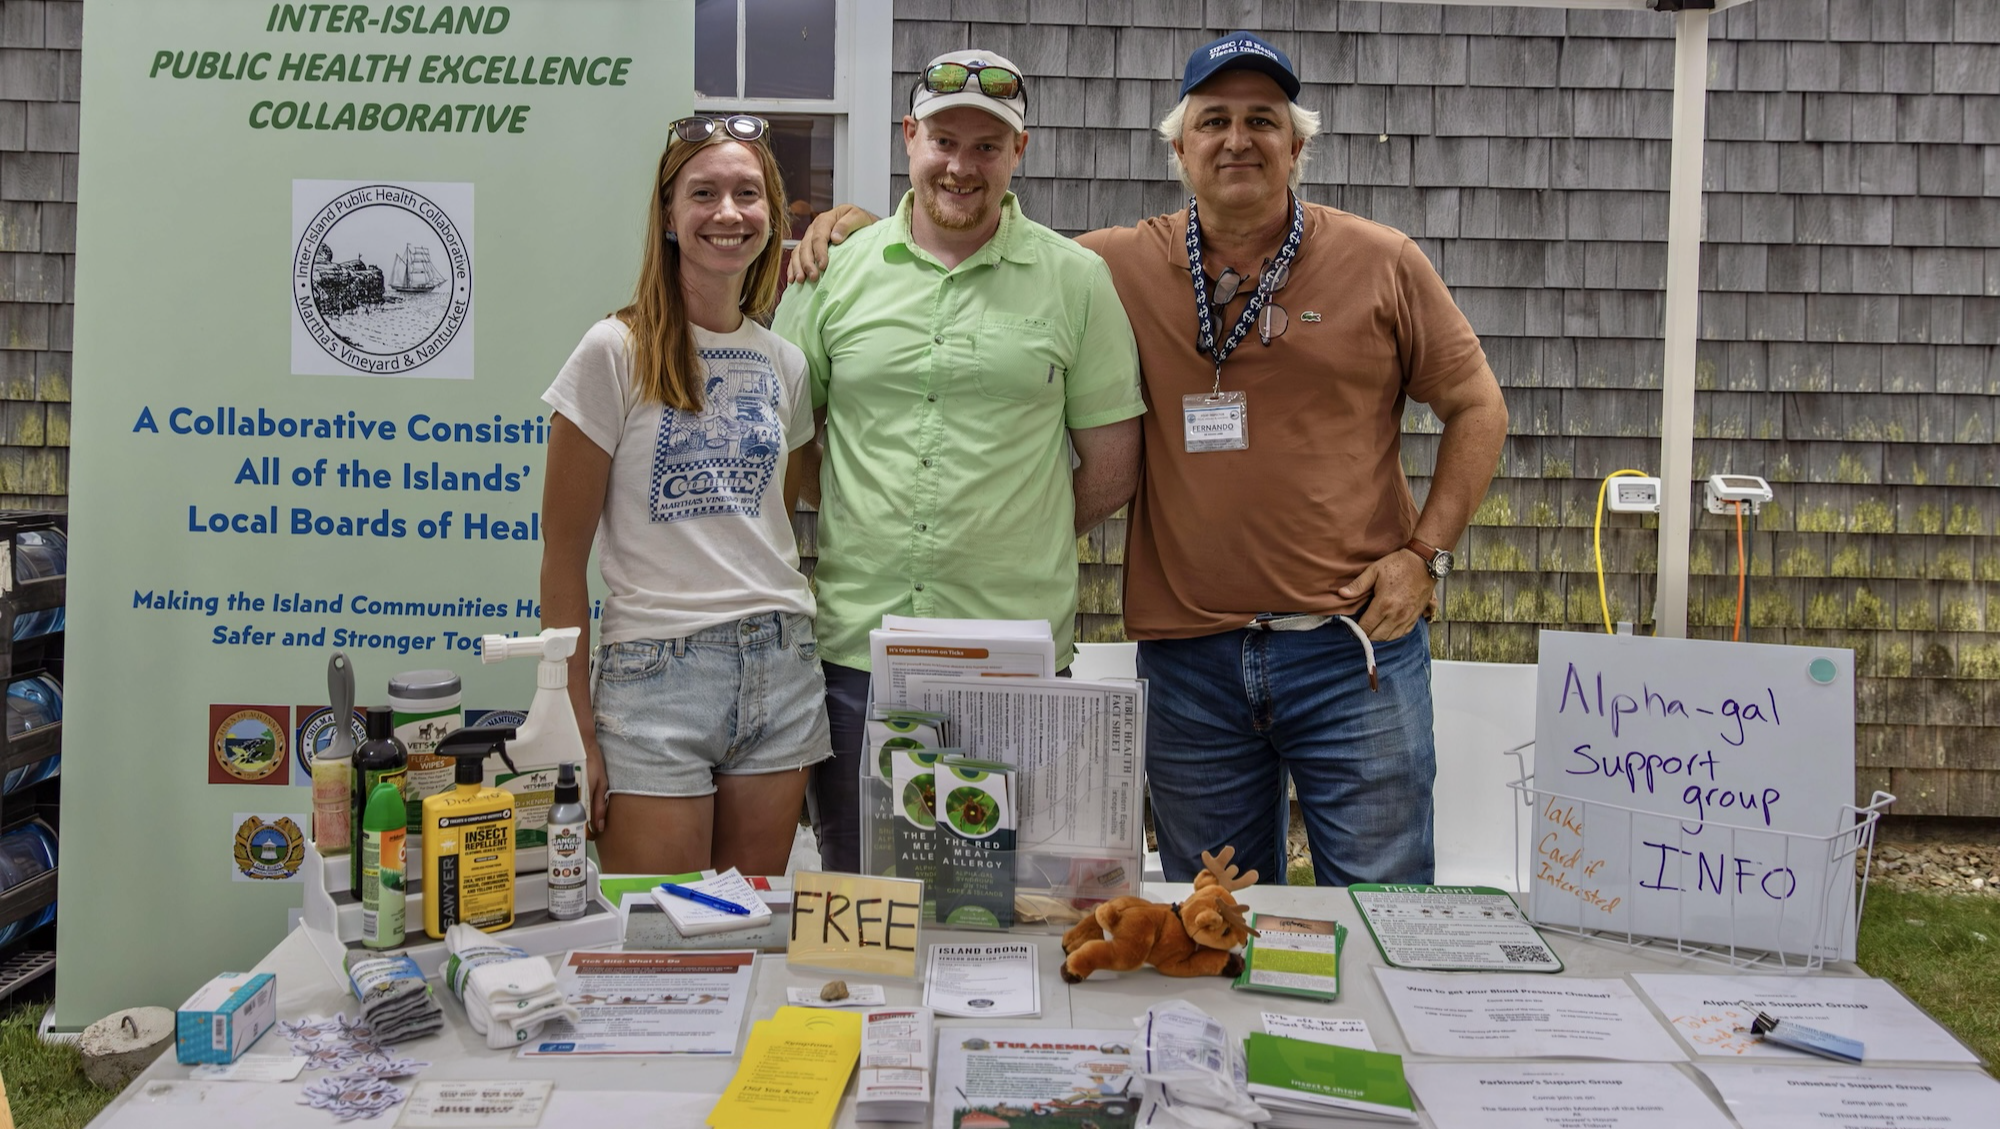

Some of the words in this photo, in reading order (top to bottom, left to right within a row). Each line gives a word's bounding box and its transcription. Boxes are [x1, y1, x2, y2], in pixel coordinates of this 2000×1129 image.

[267, 3, 510, 35] INTER-ISLAND
[149, 50, 271, 80] PUBLIC
[278, 53, 412, 83] HEALTH
[419, 55, 632, 86] EXCELLENCE
[248, 100, 531, 134] COLLABORATIVE
[297, 208, 336, 279] Inter-Island
[335, 191, 373, 214] Public
[376, 188, 417, 208] Health
[419, 201, 466, 279] Collaborative
[299, 295, 338, 352] Martha's
[341, 345, 400, 372] Vineyard
[404, 353, 415, 367] &
[416, 300, 466, 362] Nantucket
[133, 406, 159, 433] A
[168, 407, 398, 441] Collaborative
[407, 415, 551, 445] Consisti
[1192, 423, 1234, 432] FERNANDO
[234, 456, 280, 486] All
[291, 458, 327, 487] of
[336, 460, 392, 489] the
[188, 505, 278, 535] Local
[290, 507, 407, 538] Boards
[417, 511, 453, 540] of
[464, 512, 542, 541] Heal
[133, 590, 219, 616] Making
[227, 590, 265, 613] the
[272, 592, 343, 615] Island
[350, 594, 508, 619] Communities
[212, 624, 275, 646] Safer
[281, 626, 326, 648] and
[332, 628, 436, 655] Stronger
[899, 647, 916, 655] Open
[1112, 694, 1121, 717] FACT
[1559, 662, 1780, 745] Alpha-gal
[1124, 695, 1133, 729] PUBLIC
[306, 715, 333, 740] CHILMA
[1112, 719, 1121, 754] SHEET
[407, 741, 429, 750] VET'S
[1123, 731, 1132, 774] HEALTH
[411, 755, 430, 763] FLEA
[420, 761, 445, 770] WIPES
[1683, 785, 1780, 835] group
[465, 827, 508, 843] INSECT
[903, 831, 926, 839] THE
[465, 838, 508, 851] REPELLENT
[944, 838, 967, 847] THE
[975, 841, 1000, 849] RED
[954, 849, 990, 858] MEAT
[1538, 832, 1582, 869] Card
[1584, 860, 1606, 879] if
[942, 858, 1002, 869] ALLERGY
[1638, 841, 1796, 900] INFO
[955, 870, 993, 878] ALPHA-GAL
[956, 876, 994, 884] SYNDROME
[443, 857, 455, 929] SAWYER
[973, 890, 1003, 898] ISLANDS
[1380, 885, 1422, 894] Tick
[1424, 886, 1474, 895] Alert!
[1537, 861, 1621, 914] Interested
[791, 891, 919, 951] FREE
[939, 947, 981, 955] ISLAND
[985, 946, 1028, 954] GROWN
[1407, 985, 1433, 994] Want
[1448, 988, 1464, 996] get
[1521, 988, 1563, 996] Pressure
[1565, 990, 1611, 999] Checked?
[1769, 1001, 1822, 1009] Support
[1825, 1002, 1869, 1010] Group
[784, 1040, 833, 1049] Symptoms
[993, 1041, 1099, 1051] TULAREMIA
[1291, 1079, 1321, 1088] insect
[1543, 1079, 1587, 1087] Support
[1847, 1081, 1894, 1090] Support
[1896, 1084, 1933, 1092] Group
[784, 1088, 819, 1096] Know?
